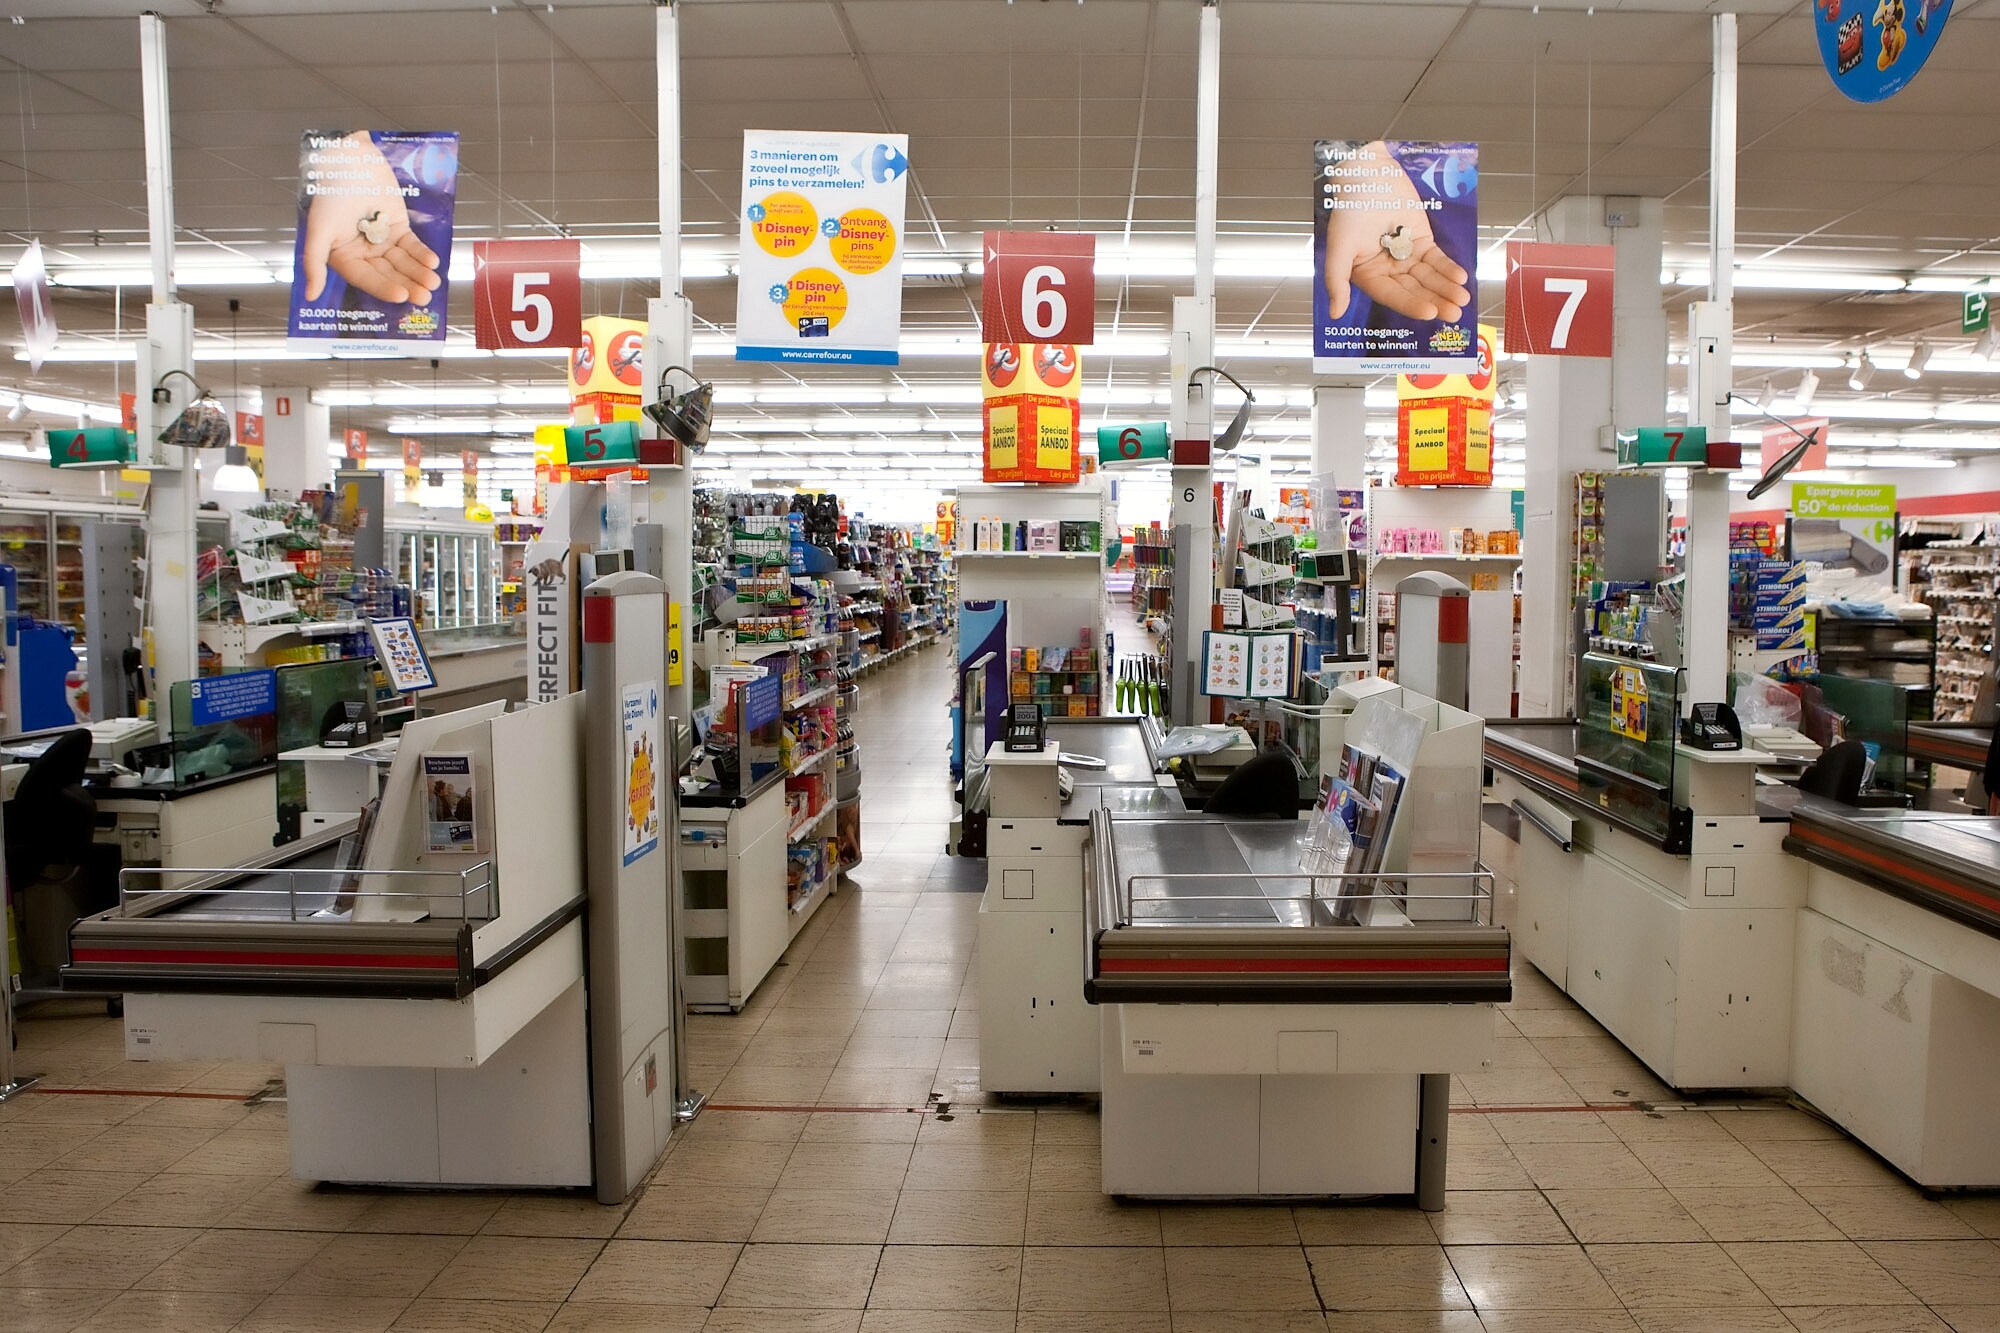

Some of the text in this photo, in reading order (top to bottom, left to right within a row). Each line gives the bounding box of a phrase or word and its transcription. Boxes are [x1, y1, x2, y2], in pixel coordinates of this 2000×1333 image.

[309, 137, 360, 149] Vind de
[308, 153, 385, 165] Gouden Pin
[750, 150, 838, 162] 3 manieren om
[1323, 148, 1376, 161] Vind de
[307, 168, 374, 180] en ontdek
[750, 164, 840, 177] zoveel mogelijk
[1323, 164, 1403, 177] Gouden Pin
[749, 176, 865, 189] pins te verzamelen!
[1323, 182, 1393, 193] en ontdek
[306, 184, 420, 198] Disneyland Paris
[1323, 198, 1443, 211] Disneyland Paris
[757, 223, 763, 233] 1
[840, 217, 887, 229] Ontvang
[774, 235, 796, 248] pin
[851, 240, 874, 251] pins
[787, 280, 793, 290] 1
[805, 291, 826, 304] pin
[1021, 265, 1067, 338] 6
[511, 272, 553, 343] 5
[1544, 278, 1588, 349] 7
[299, 308, 385, 321] 50.000 toegangs-
[408, 314, 432, 323] NEW
[298, 321, 389, 332] kaarten te winnen!
[1324, 327, 1414, 339] 50.000 toegangs-
[1438, 332, 1463, 341] NEW
[331, 343, 399, 352] www.carrefour.eu
[1324, 340, 1418, 350] kaarten te winnen!
[782, 351, 852, 360] www.carrefour.eu
[1360, 362, 1431, 370] www.carrefour.eu
[602, 394, 640, 404] De prijzen
[1028, 394, 1061, 405] De prijzen
[1413, 399, 1428, 408] prix
[992, 424, 1015, 436] Speciaal
[1040, 425, 1069, 435] Speciaal
[1414, 427, 1445, 436] Speciaal
[67, 433, 89, 461] 4
[584, 428, 606, 460] 5
[992, 436, 1015, 449] AANBOD
[1040, 437, 1069, 450] AANBOD
[1119, 427, 1142, 459] 6
[1664, 432, 1684, 462] 7
[1050, 470, 1076, 480] Les prix
[1419, 472, 1456, 481] De prijzen
[1184, 488, 1195, 502] 6
[1806, 487, 1881, 498] Epargnez pour
[1828, 503, 1840, 512] de
[1842, 503, 1889, 512] réduction
[538, 583, 558, 616] FIT
[538, 622, 558, 703] ERFECT
